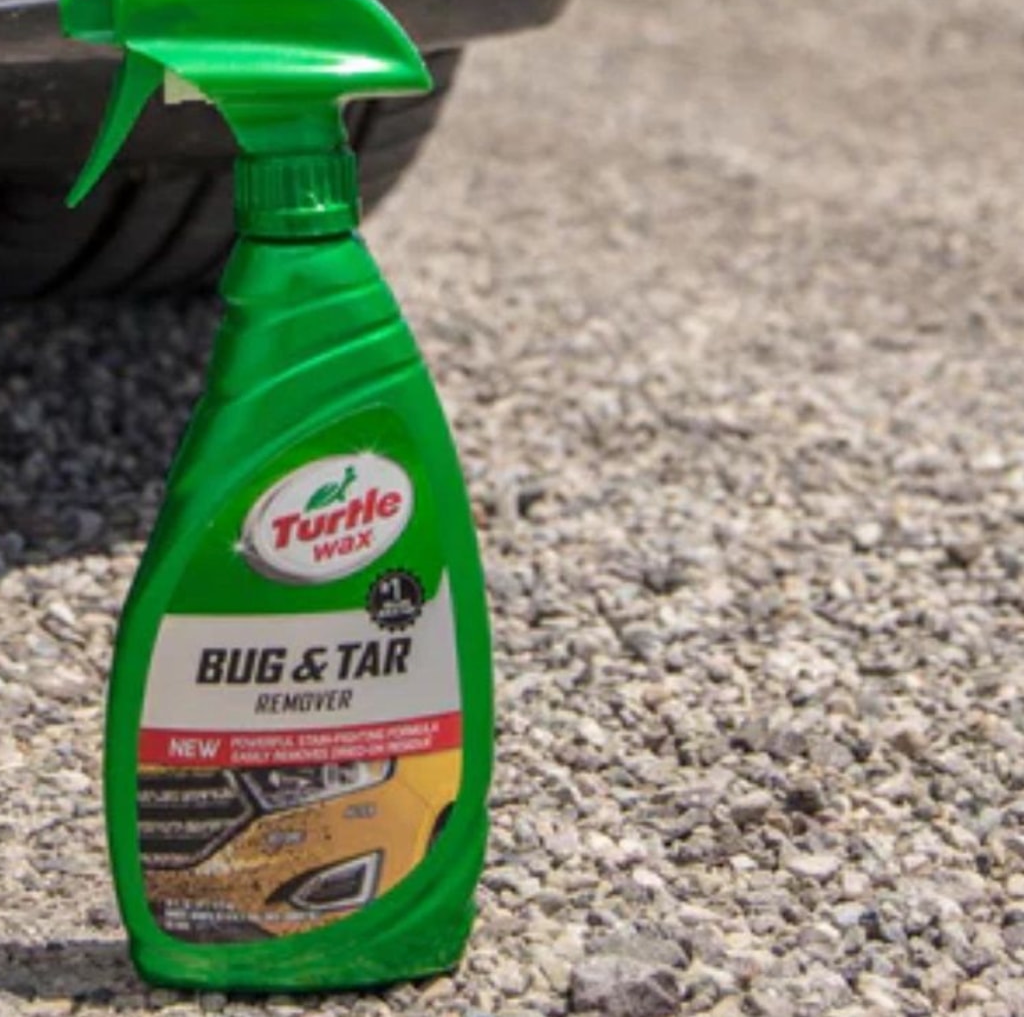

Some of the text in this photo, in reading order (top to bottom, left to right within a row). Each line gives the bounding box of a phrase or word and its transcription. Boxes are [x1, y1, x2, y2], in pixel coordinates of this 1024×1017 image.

[272, 488, 403, 549] Turtle
[314, 530, 374, 562] wax
[195, 637, 412, 685] BUG & TAR
[254, 689, 353, 715] REMOVER
[168, 738, 221, 760] NEW
